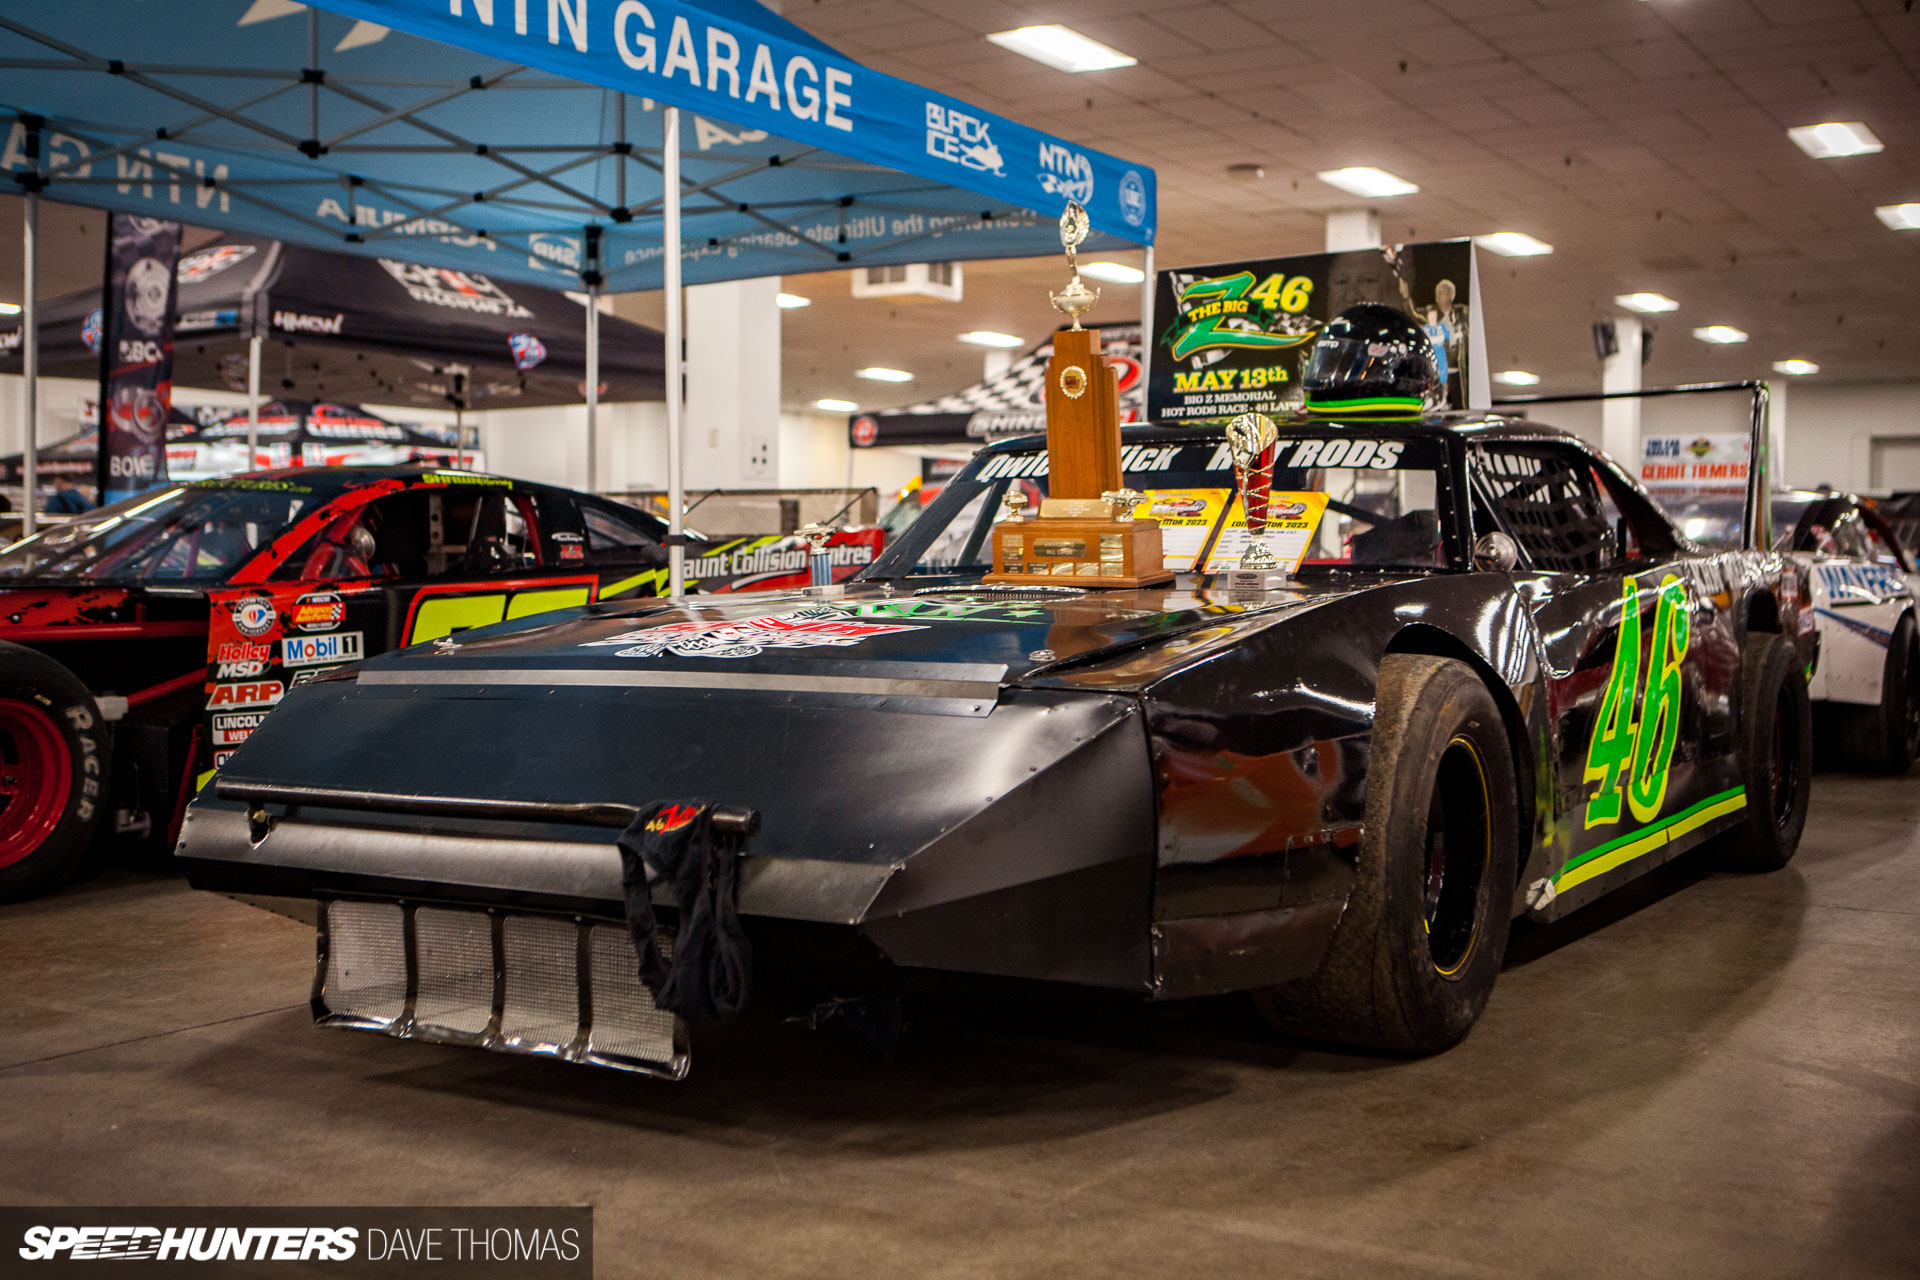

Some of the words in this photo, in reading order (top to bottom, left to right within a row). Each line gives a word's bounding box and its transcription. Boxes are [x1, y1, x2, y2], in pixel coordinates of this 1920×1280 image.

[613, 0, 853, 132] GARAGE
[926, 101, 990, 143] BLACK
[926, 129, 960, 163] ICE
[1039, 141, 1082, 180] NTN
[1251, 273, 1314, 313] 46
[1187, 302, 1222, 322] THE
[1221, 299, 1250, 314] BIG
[1173, 369, 1238, 394] MAY
[1239, 366, 1288, 389] 13th
[1161, 407, 1186, 418] HOT
[1186, 405, 1217, 416] RODS
[1218, 403, 1248, 414] RACE
[1255, 402, 1269, 412] 46
[1270, 400, 1300, 412] LAPS
[1184, 395, 1204, 405] BIG
[1205, 394, 1214, 404] Z
[1214, 390, 1277, 403] MEMORIAL
[1206, 441, 1293, 470] HT
[1288, 439, 1405, 469] RODS
[1285, 521, 1309, 529] 2023
[731, 547, 807, 577] Collision
[218, 642, 271, 664] Holley
[287, 635, 337, 660] Mobil
[345, 636, 353, 653] 1
[216, 662, 264, 679] MSD
[209, 682, 282, 706] ARP
[1583, 573, 1690, 830] 46
[65, 705, 100, 820] RACER
